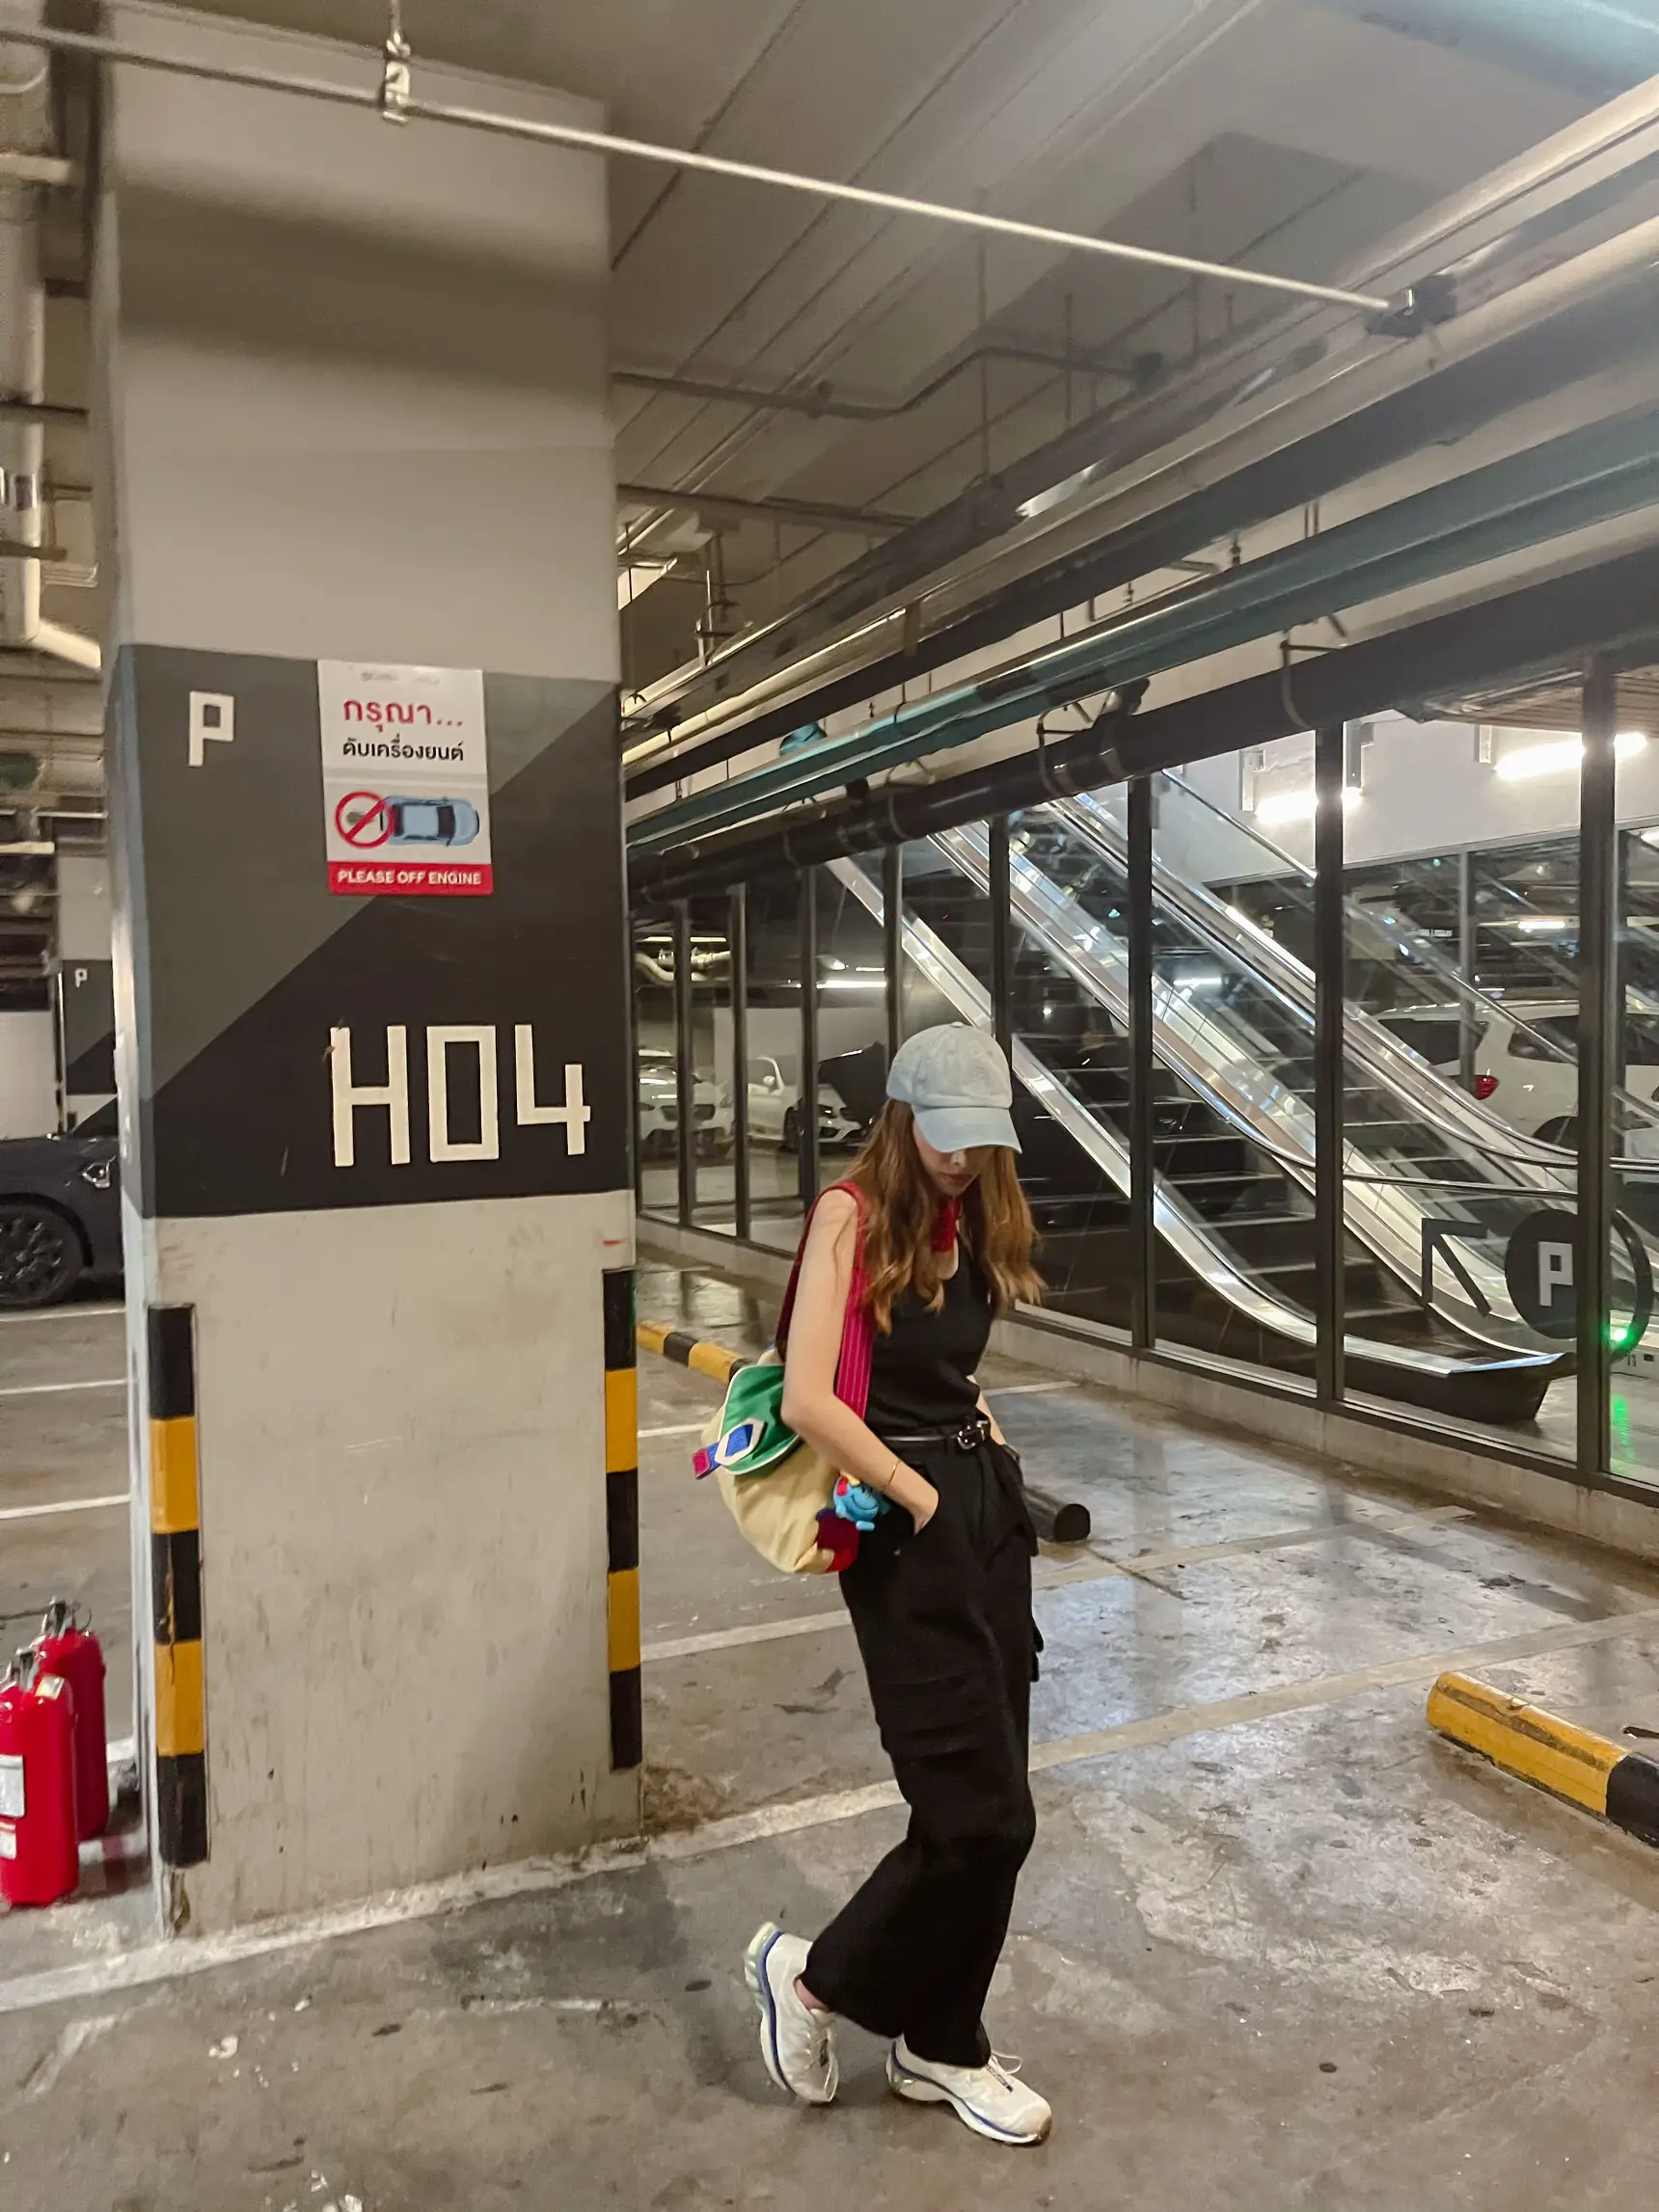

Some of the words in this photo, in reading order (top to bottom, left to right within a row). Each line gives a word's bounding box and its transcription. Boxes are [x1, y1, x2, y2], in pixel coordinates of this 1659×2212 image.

[188, 690, 235, 768] P
[342, 699, 464, 733] กรุณา...
[342, 733, 464, 762] ดับเครื่องยนต์
[338, 869, 394, 884] PLEASE
[396, 871, 426, 884] OFF
[428, 872, 481, 885] ENGINE
[74, 967, 88, 988] P
[1538, 1241, 1573, 1307] P
